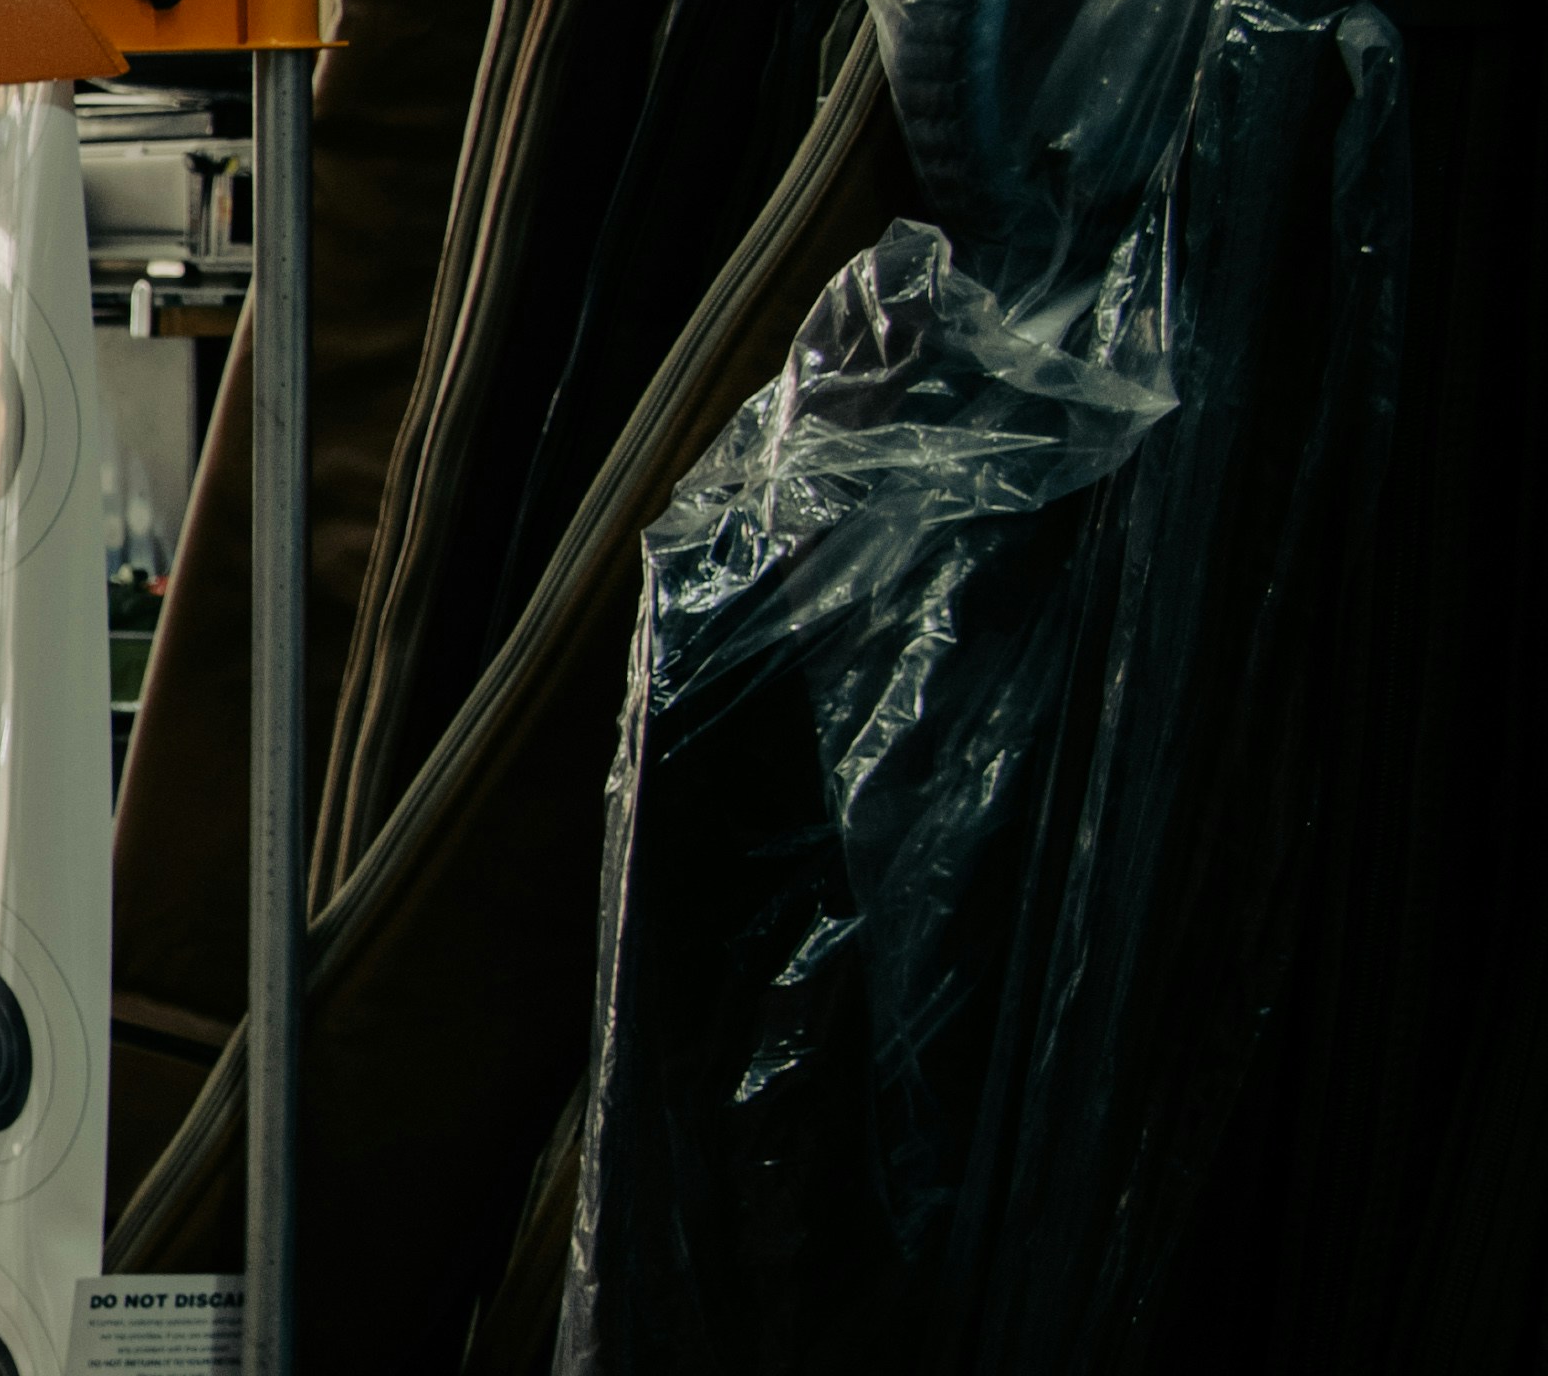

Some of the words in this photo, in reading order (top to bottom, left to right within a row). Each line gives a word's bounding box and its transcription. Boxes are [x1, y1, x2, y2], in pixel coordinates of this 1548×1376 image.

[90, 1294, 117, 1309] DO
[124, 1293, 168, 1308] NOT
[175, 1291, 245, 1308] DISCA
